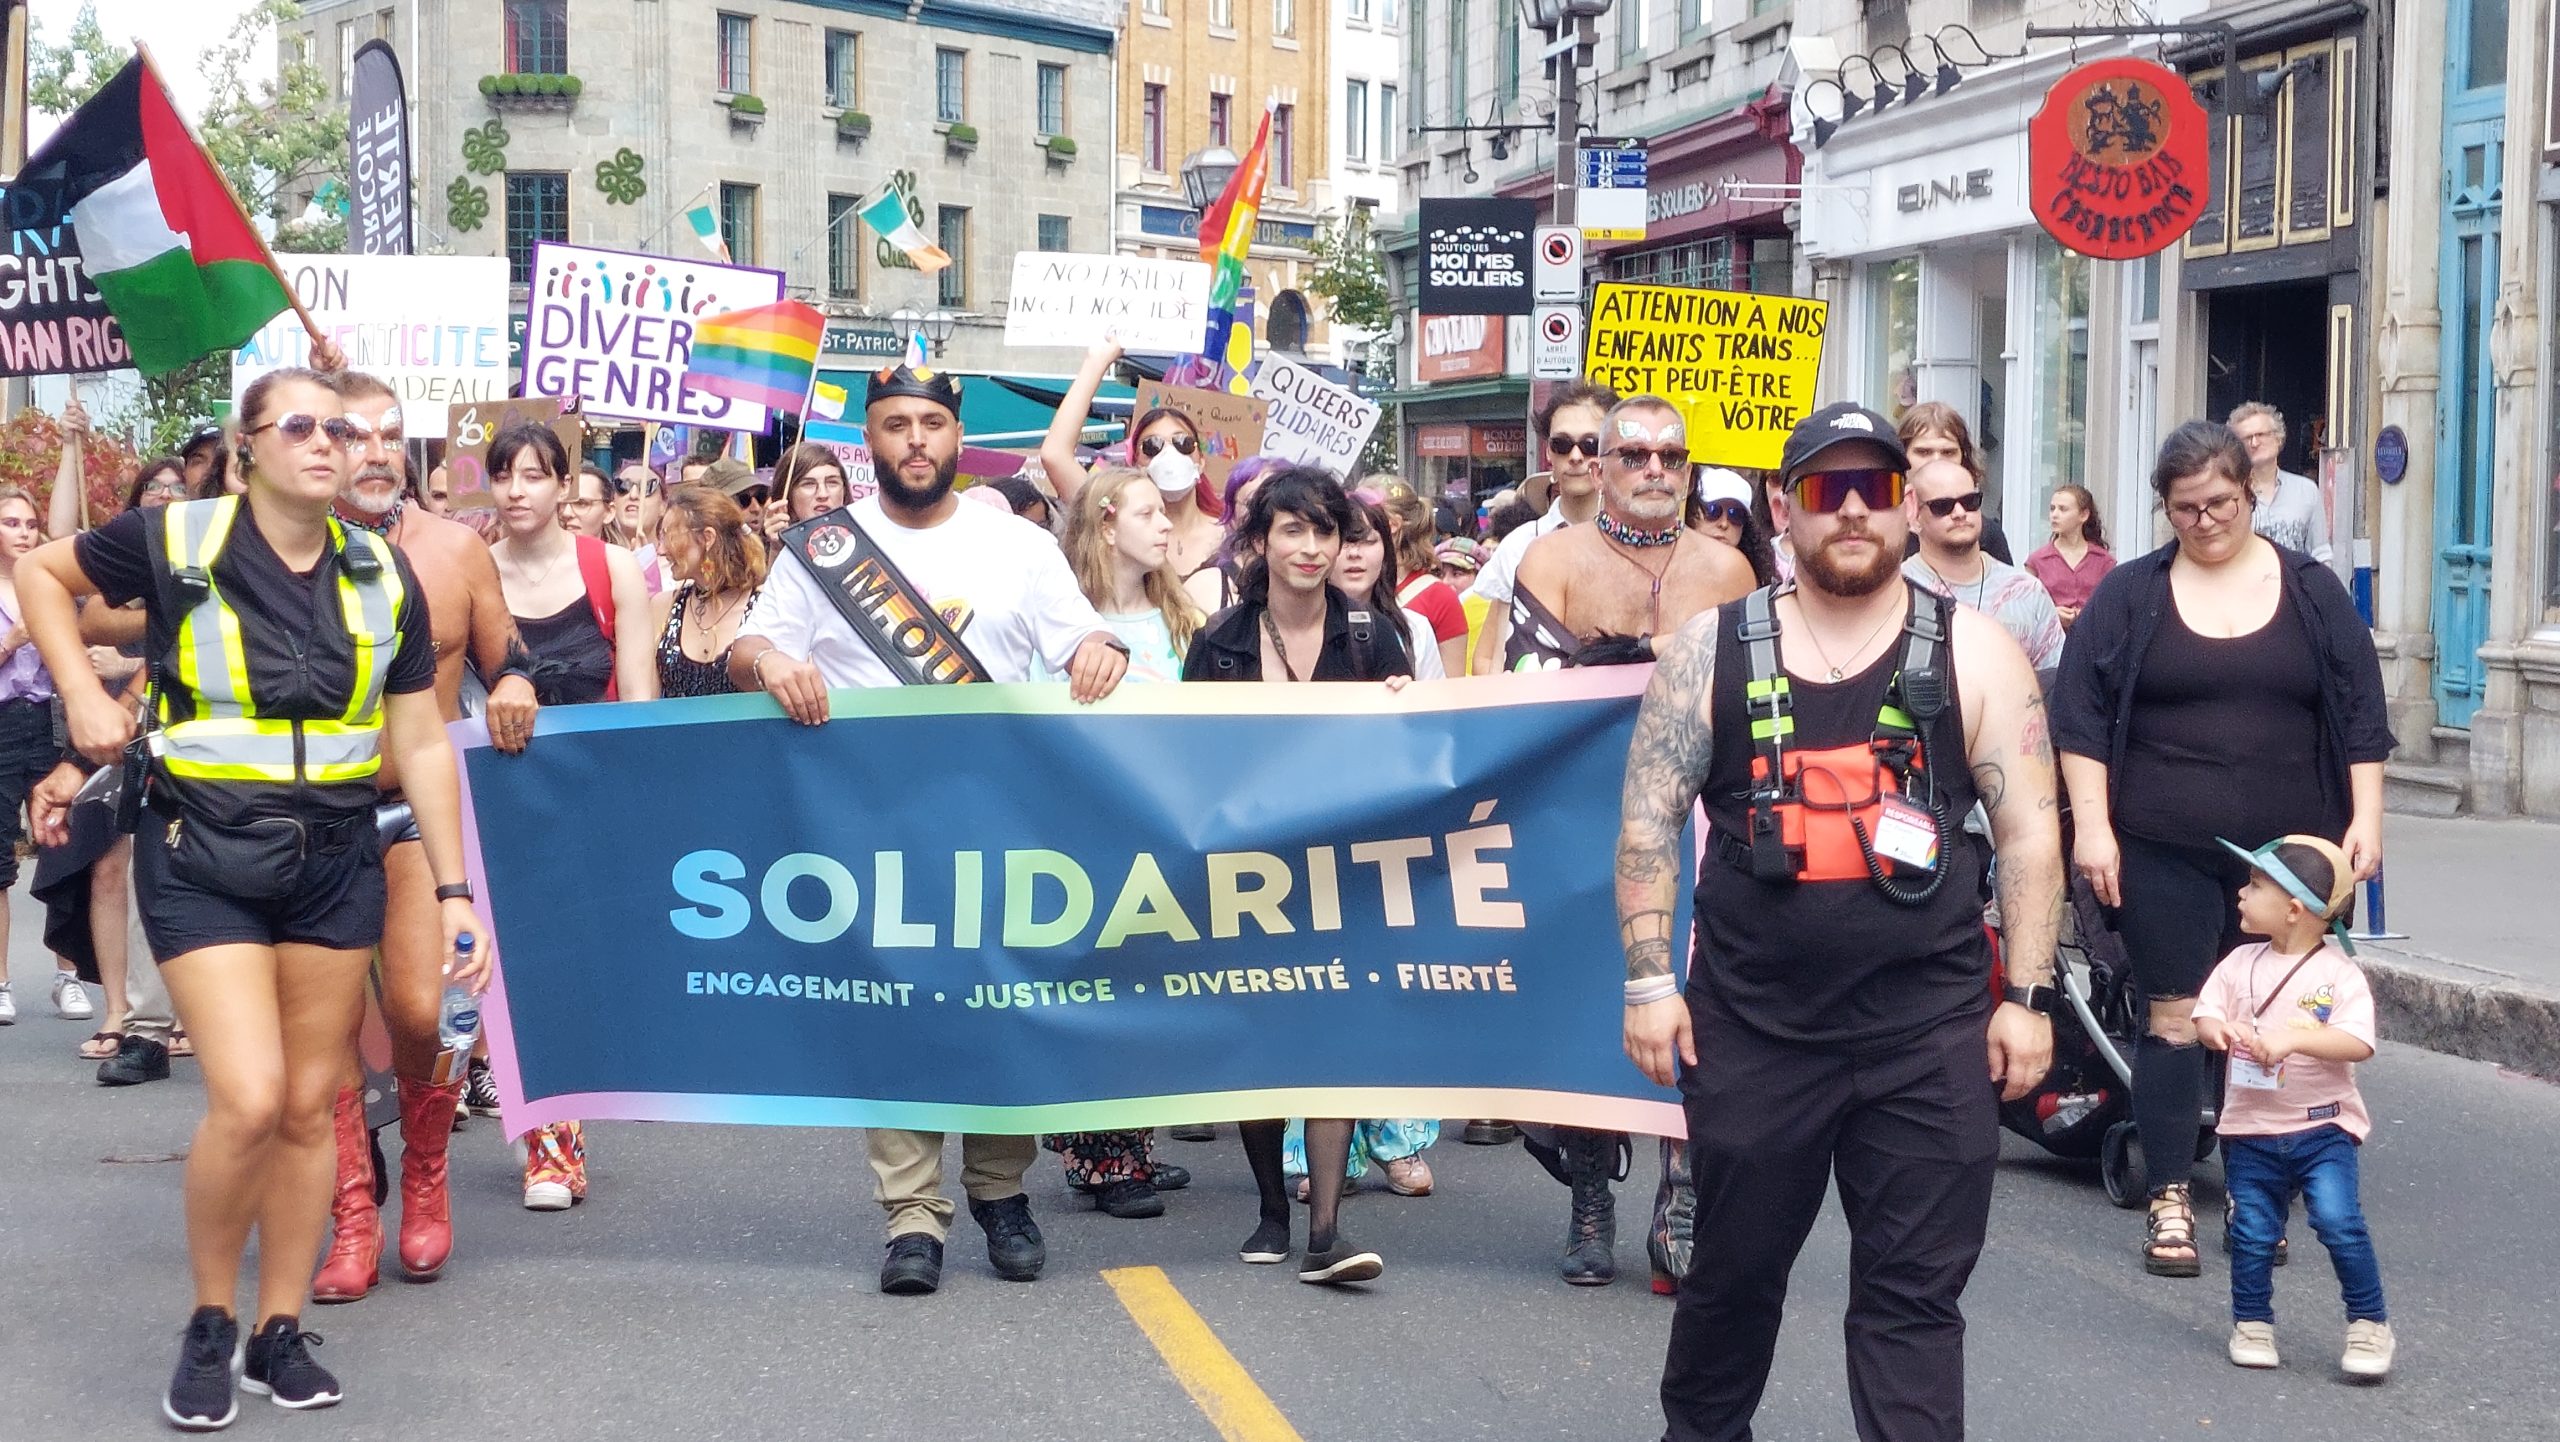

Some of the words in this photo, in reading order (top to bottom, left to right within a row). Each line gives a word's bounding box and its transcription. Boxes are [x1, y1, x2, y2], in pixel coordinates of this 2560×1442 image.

[1598, 164, 1613, 175] 25
[1599, 151, 1612, 163] 11
[1430, 254, 1468, 269] MOI
[1475, 254, 1514, 269] MES
[1431, 243, 1489, 252] BOUTIQUES
[1430, 271, 1524, 286] SOULIERS
[540, 292, 696, 365] DIVER
[1600, 291, 1740, 327] ATTENTION
[1746, 294, 1767, 331] À
[1777, 304, 1824, 338] NOS
[1595, 329, 1705, 363] ENFANTS
[1271, 366, 1370, 429] QUEERS
[1591, 362, 1657, 393] C'EST
[1666, 365, 1792, 399] PEUT-ÊTRE
[1719, 399, 1799, 431] VÔTRE
[669, 799, 1526, 949] SOLIDARITÉ
[686, 970, 914, 1007] ENGAGEMENT
[964, 977, 1115, 1010] JUSTICE
[1163, 957, 1350, 998] DIVERSITÉ
[1399, 957, 1518, 992] FIERTÉ
